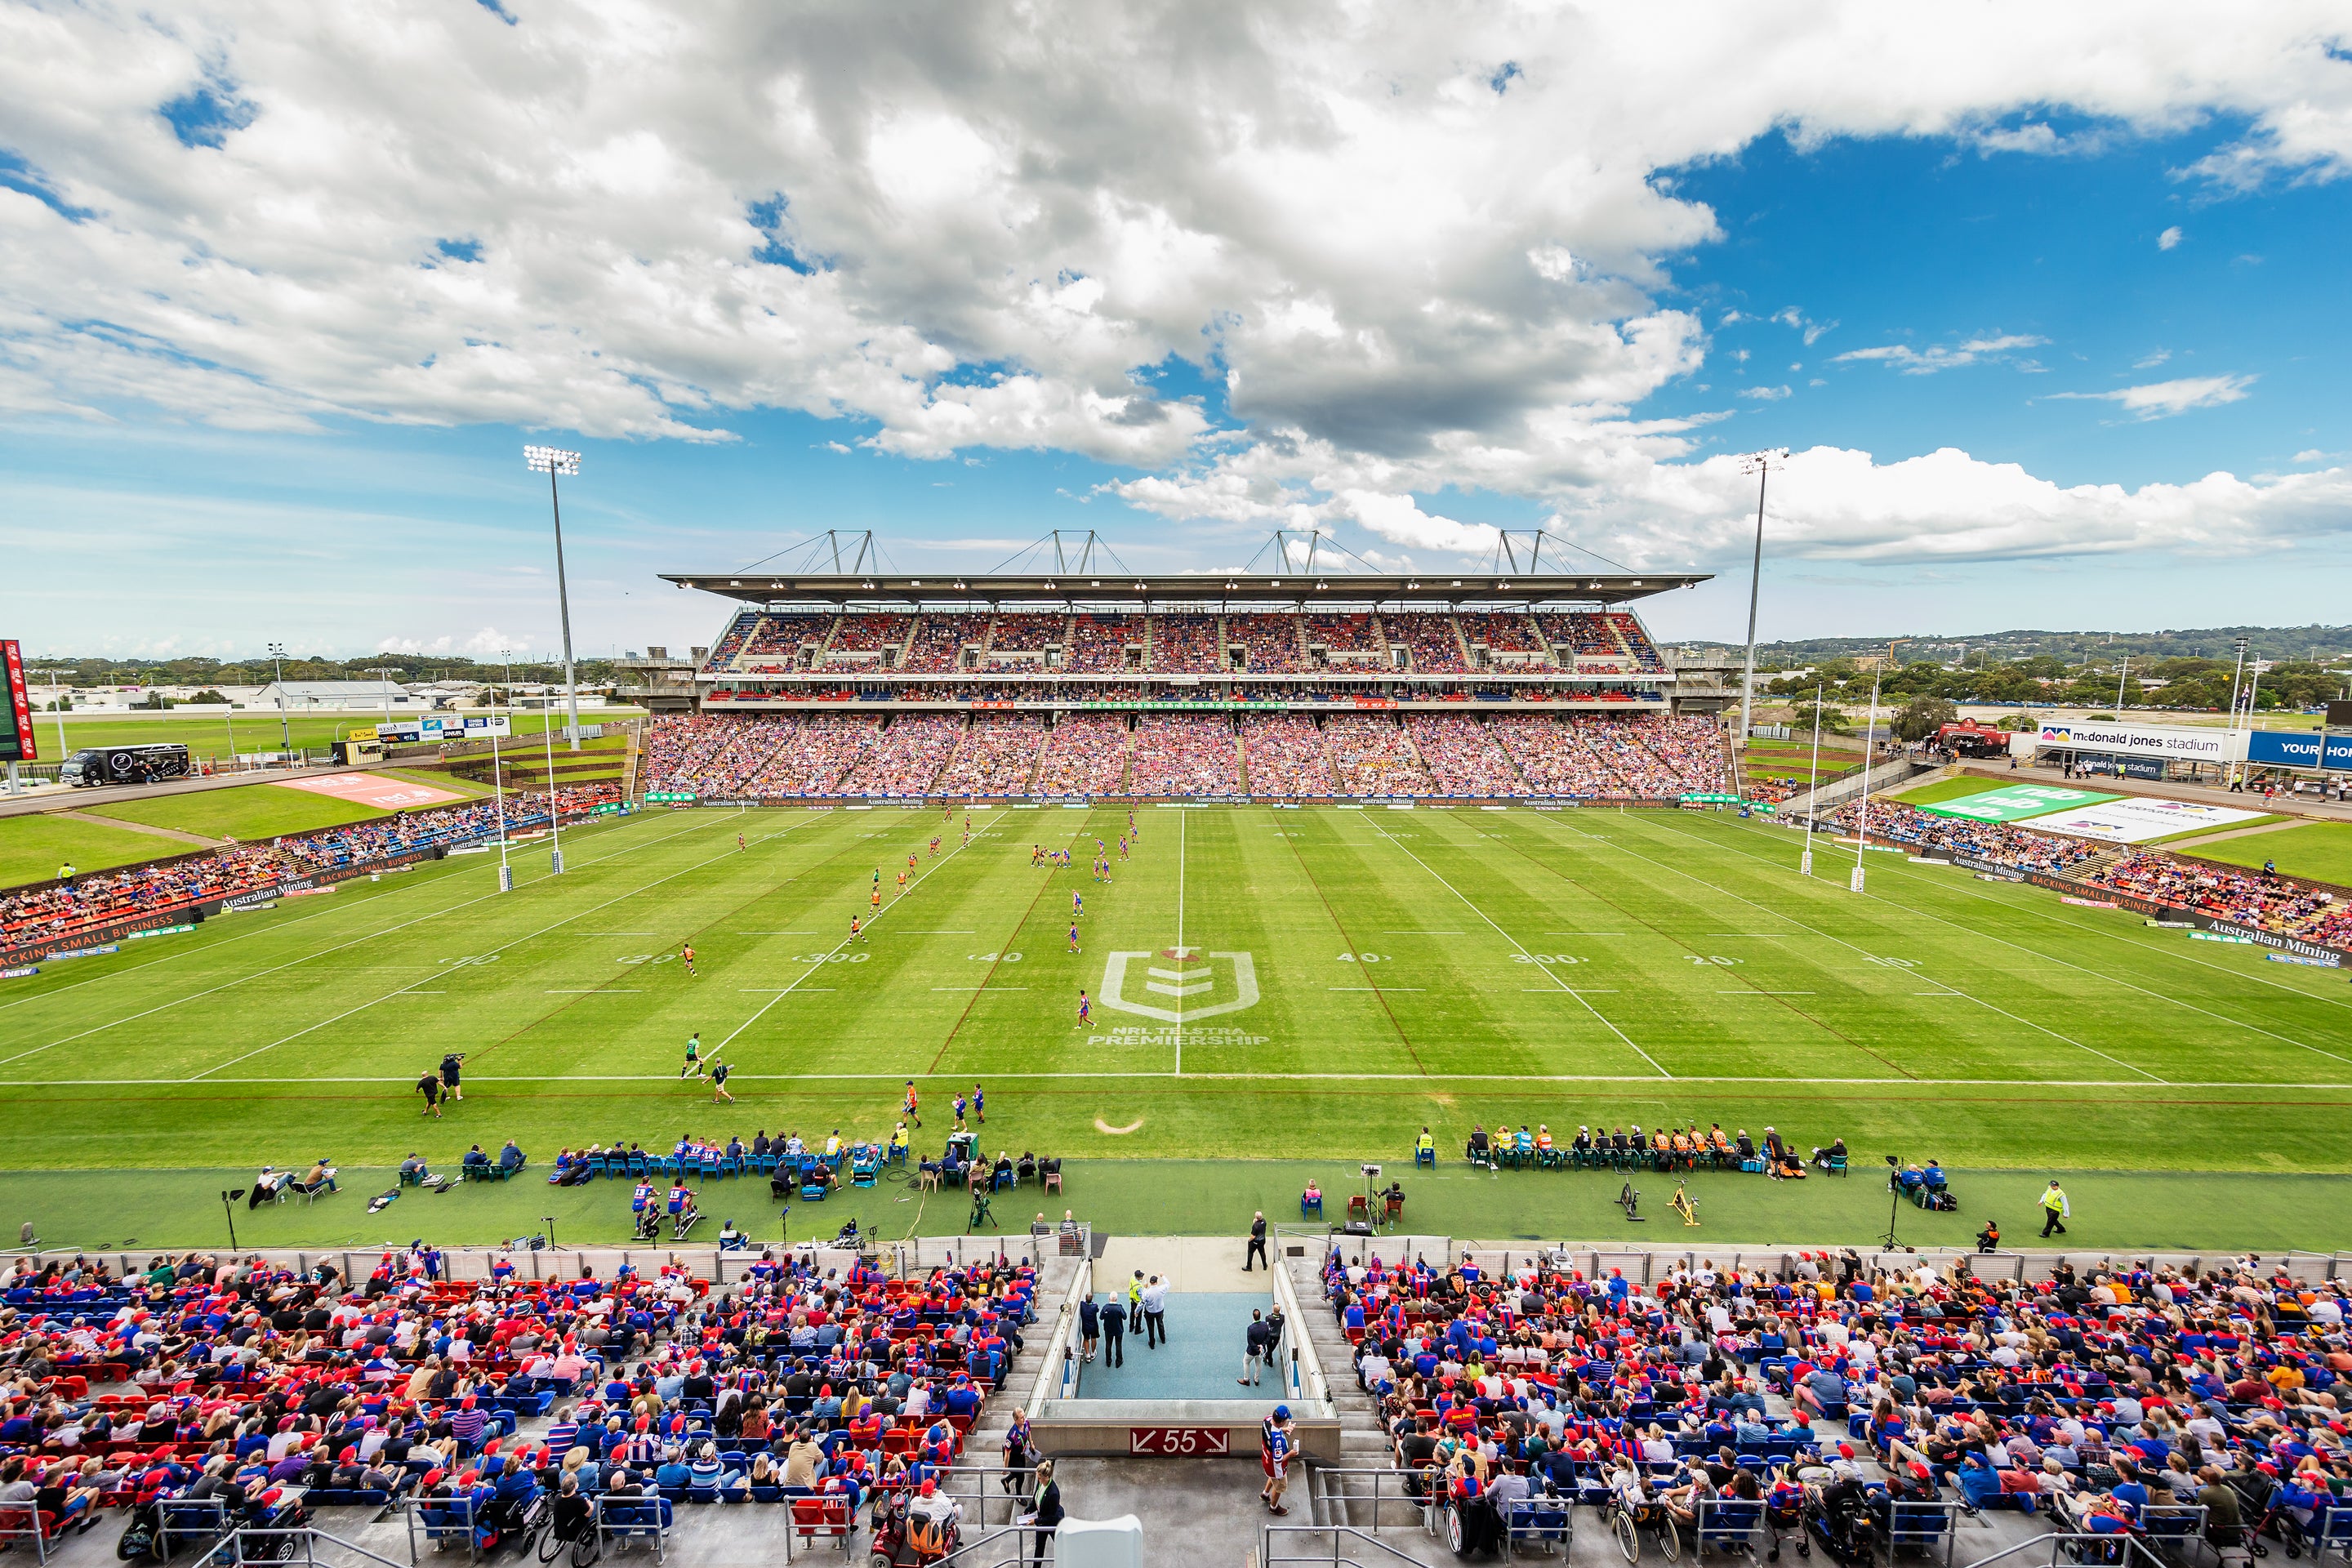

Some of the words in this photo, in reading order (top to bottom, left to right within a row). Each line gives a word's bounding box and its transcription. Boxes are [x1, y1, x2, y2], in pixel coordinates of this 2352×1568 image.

[2073, 731, 2126, 744] mcdonald
[2129, 735, 2163, 747] jones
[2166, 737, 2218, 752] stadium
[2281, 743, 2320, 755] YOUR
[2127, 764, 2156, 773] stadium
[298, 778, 338, 786] red
[371, 793, 410, 803] red
[2012, 788, 2086, 800] nib
[1973, 797, 2044, 809] nib
[1938, 805, 2003, 818] nib
[1827, 824, 1847, 836] Mining
[483, 834, 504, 844] Minin
[1850, 831, 1874, 842] BACING
[1876, 837, 1894, 848] SMALL
[1896, 842, 1923, 855] BUSINES
[320, 868, 358, 884] BACKING
[360, 862, 386, 873] SMALL
[389, 853, 422, 867] BUSINESS
[1953, 856, 1993, 873] Australian
[1994, 865, 2025, 882] Mining
[221, 888, 277, 909] Australian
[279, 879, 313, 895] Mining
[2032, 875, 2072, 892] BACKING
[2075, 886, 2106, 901] SMALL
[0, 945, 56, 967] ACKING
[62, 933, 108, 951] SMALL
[113, 915, 174, 938] BUSINESS
[2209, 920, 2282, 947] Australian
[2284, 938, 2341, 961] Mining
[629, 954, 676, 964] 20
[804, 953, 871, 963] 300
[978, 952, 1024, 962] 40
[1336, 952, 1380, 962] 40
[1509, 954, 1578, 964] 300
[1684, 956, 1732, 966] 20
[5, 968, 32, 977] NEW
[1087, 1036, 1270, 1045] PREMIERSHIP
[669, 1190, 680, 1198] 15
[1163, 1430, 1197, 1453] 55
